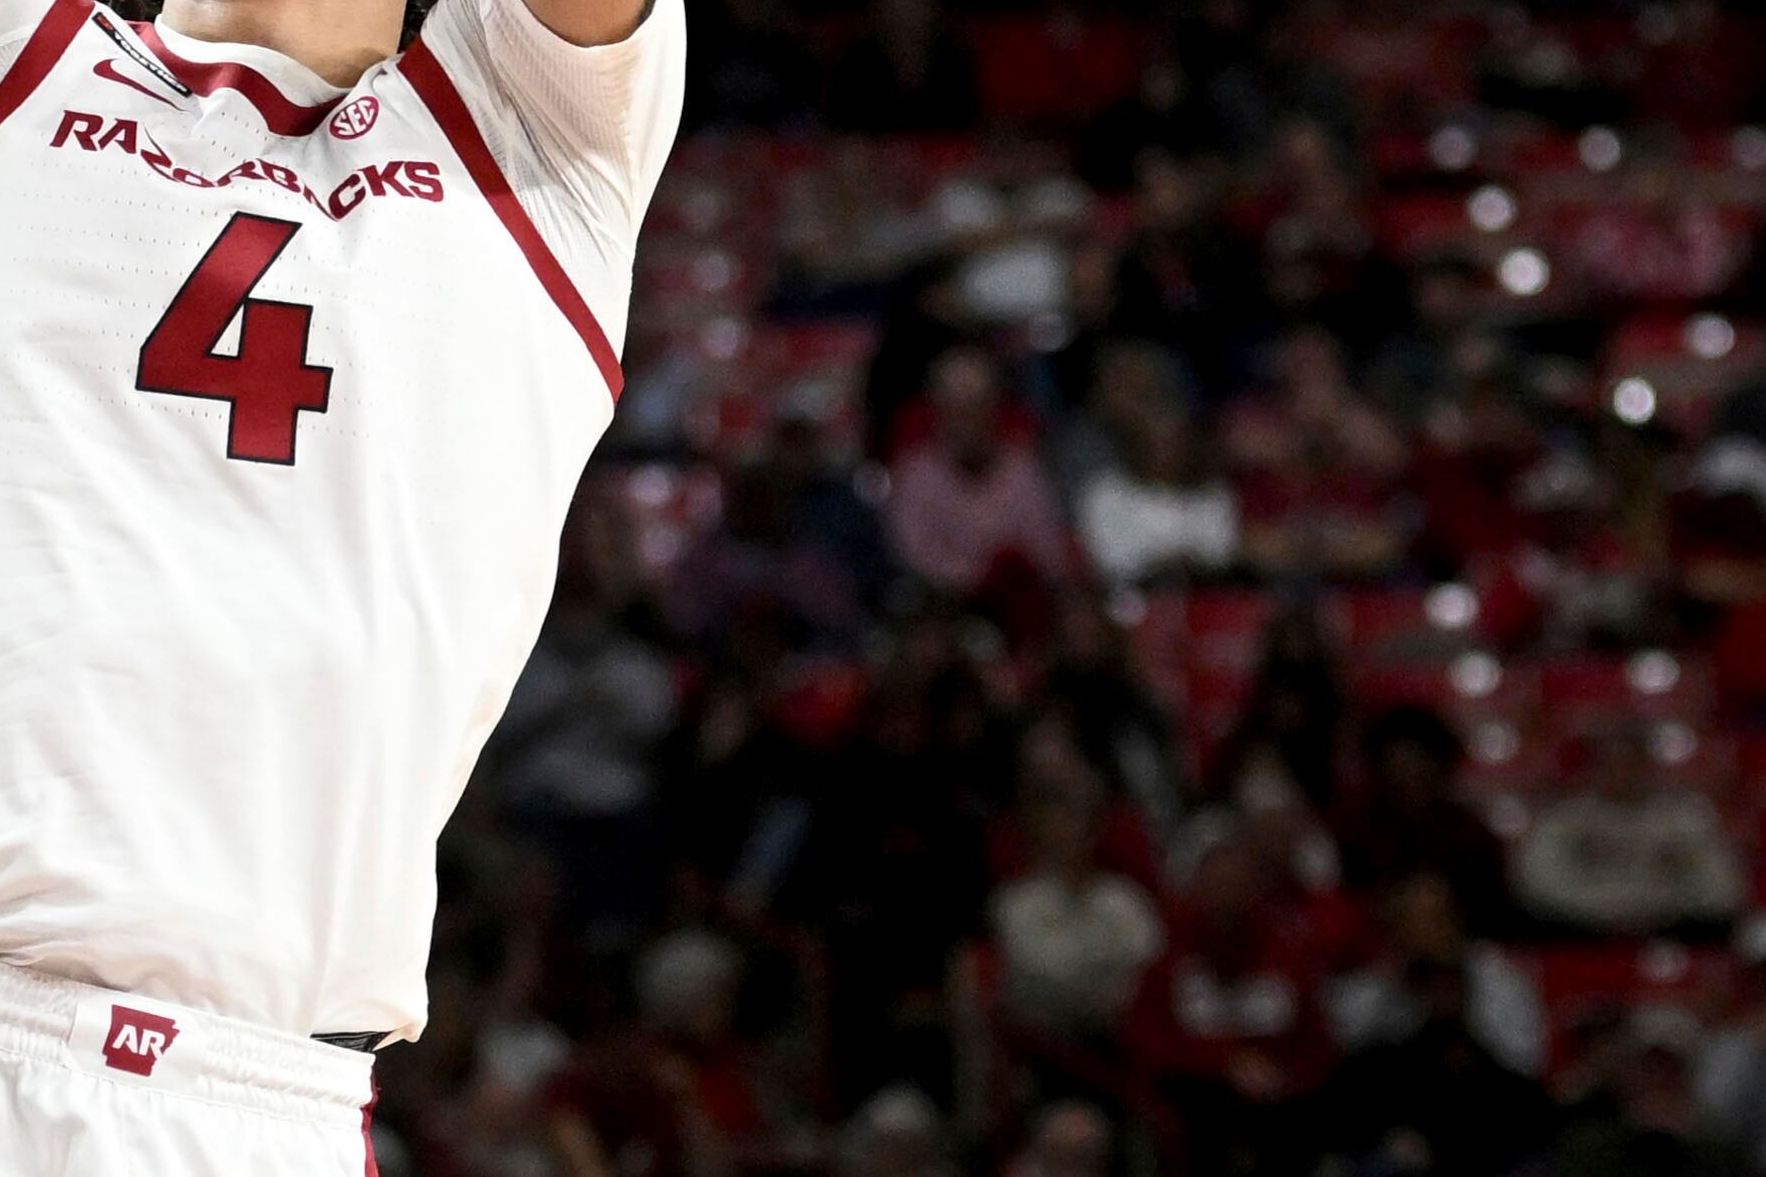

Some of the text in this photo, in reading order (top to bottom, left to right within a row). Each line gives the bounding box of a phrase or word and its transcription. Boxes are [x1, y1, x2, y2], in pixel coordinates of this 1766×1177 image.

[334, 99, 376, 136] SEC
[135, 210, 334, 467] 4
[112, 1023, 168, 1059] AR
